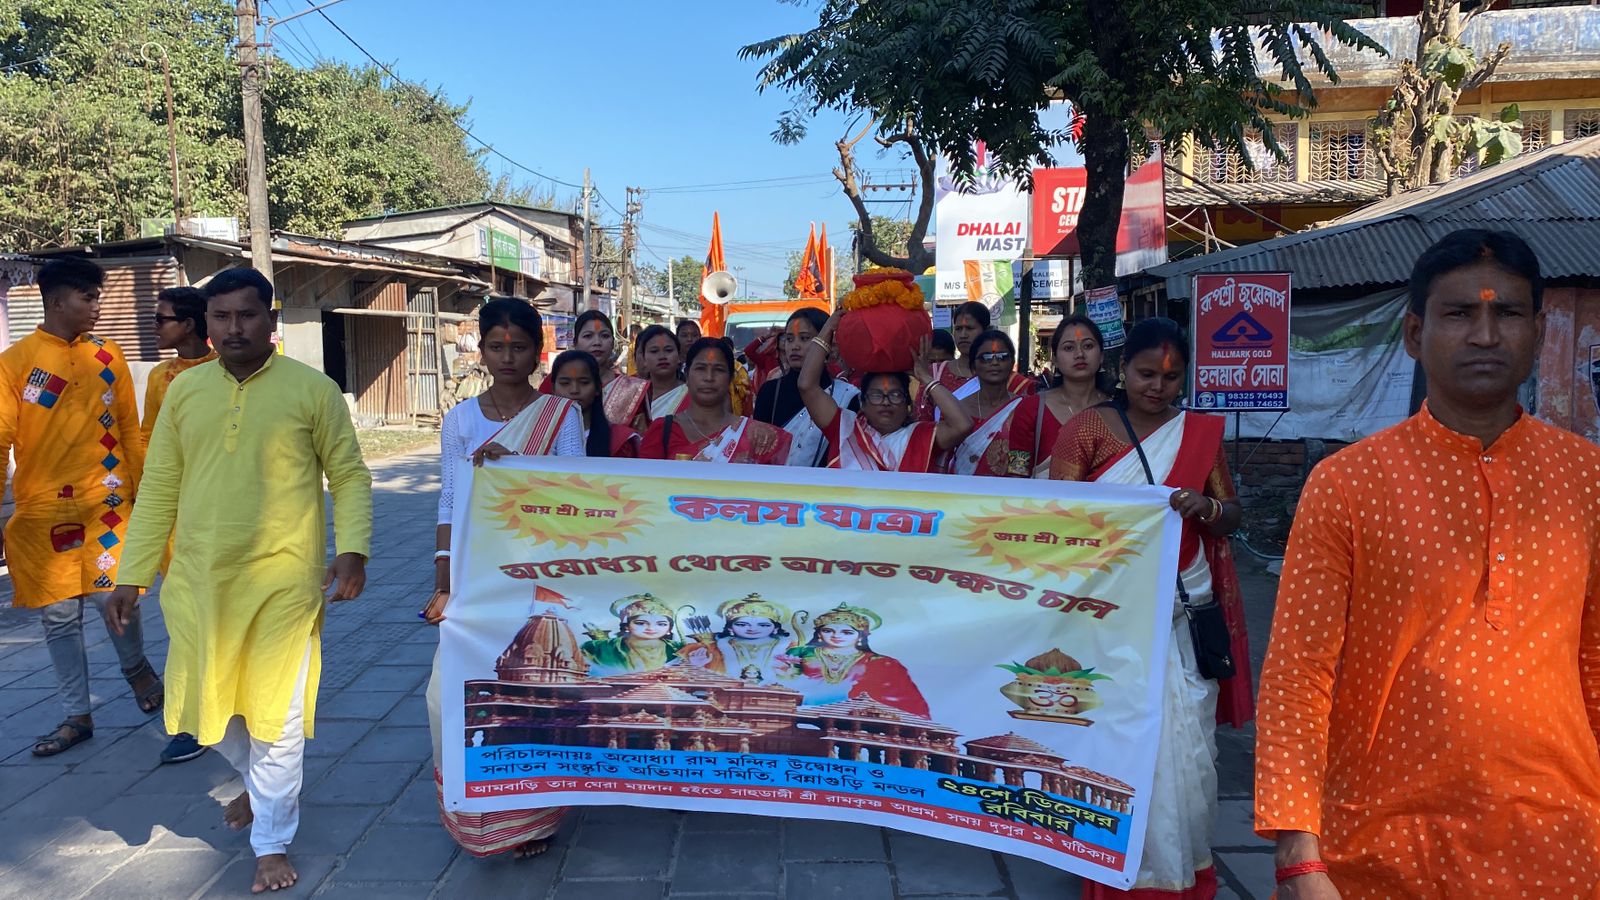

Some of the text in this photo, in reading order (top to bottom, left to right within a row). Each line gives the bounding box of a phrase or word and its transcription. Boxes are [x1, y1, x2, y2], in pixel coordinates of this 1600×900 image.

[1052, 186, 1087, 213] STA
[957, 222, 1021, 236] DHALAI
[1058, 214, 1079, 227] CEM
[976, 237, 1026, 251] MAST
[1032, 271, 1055, 279] EALER
[944, 281, 961, 290] M/S
[1211, 350, 1272, 358] HALLMARK GOLD
[1198, 358, 1285, 388] হলমার্ক সোনা
[1227, 392, 1284, 400] 98325 76493
[1257, 400, 1284, 408] 74652
[520, 503, 618, 518] জয় শ্রী রাম
[671, 495, 940, 536] কলস যাত্রা
[993, 531, 1102, 548] জয় শ্রী রাম
[499, 554, 1121, 620] অযোধ্যা থেকে আগত অক্ষত চাল
[602, 752, 675, 765] অযোধ্যা
[685, 755, 717, 766] রাম
[727, 754, 778, 769] মন্দির
[787, 757, 858, 776] উদ্বোধন
[867, 769, 885, 779] ও
[480, 761, 547, 775] সনাতন
[556, 760, 620, 776] সংস্কৃতি
[628, 764, 705, 779] অভিযান
[784, 770, 865, 791] বিন্নাগুড়ি
[942, 778, 1117, 829] ২৪শে ডিসেম্বর
[470, 779, 540, 793] আমবাড়ি
[546, 779, 579, 789] তার
[624, 783, 673, 793] ময়দান
[680, 785, 724, 795] হইতে
[799, 789, 817, 801] শ্রী
[825, 794, 882, 808] রামকৃষ্ণ
[946, 811, 981, 827] সময়
[988, 820, 1025, 838] দুপুর
[1032, 831, 1055, 845] ১২
[1060, 838, 1117, 865] ঘটিকায়
[985, 801, 1073, 831] রবিবার
